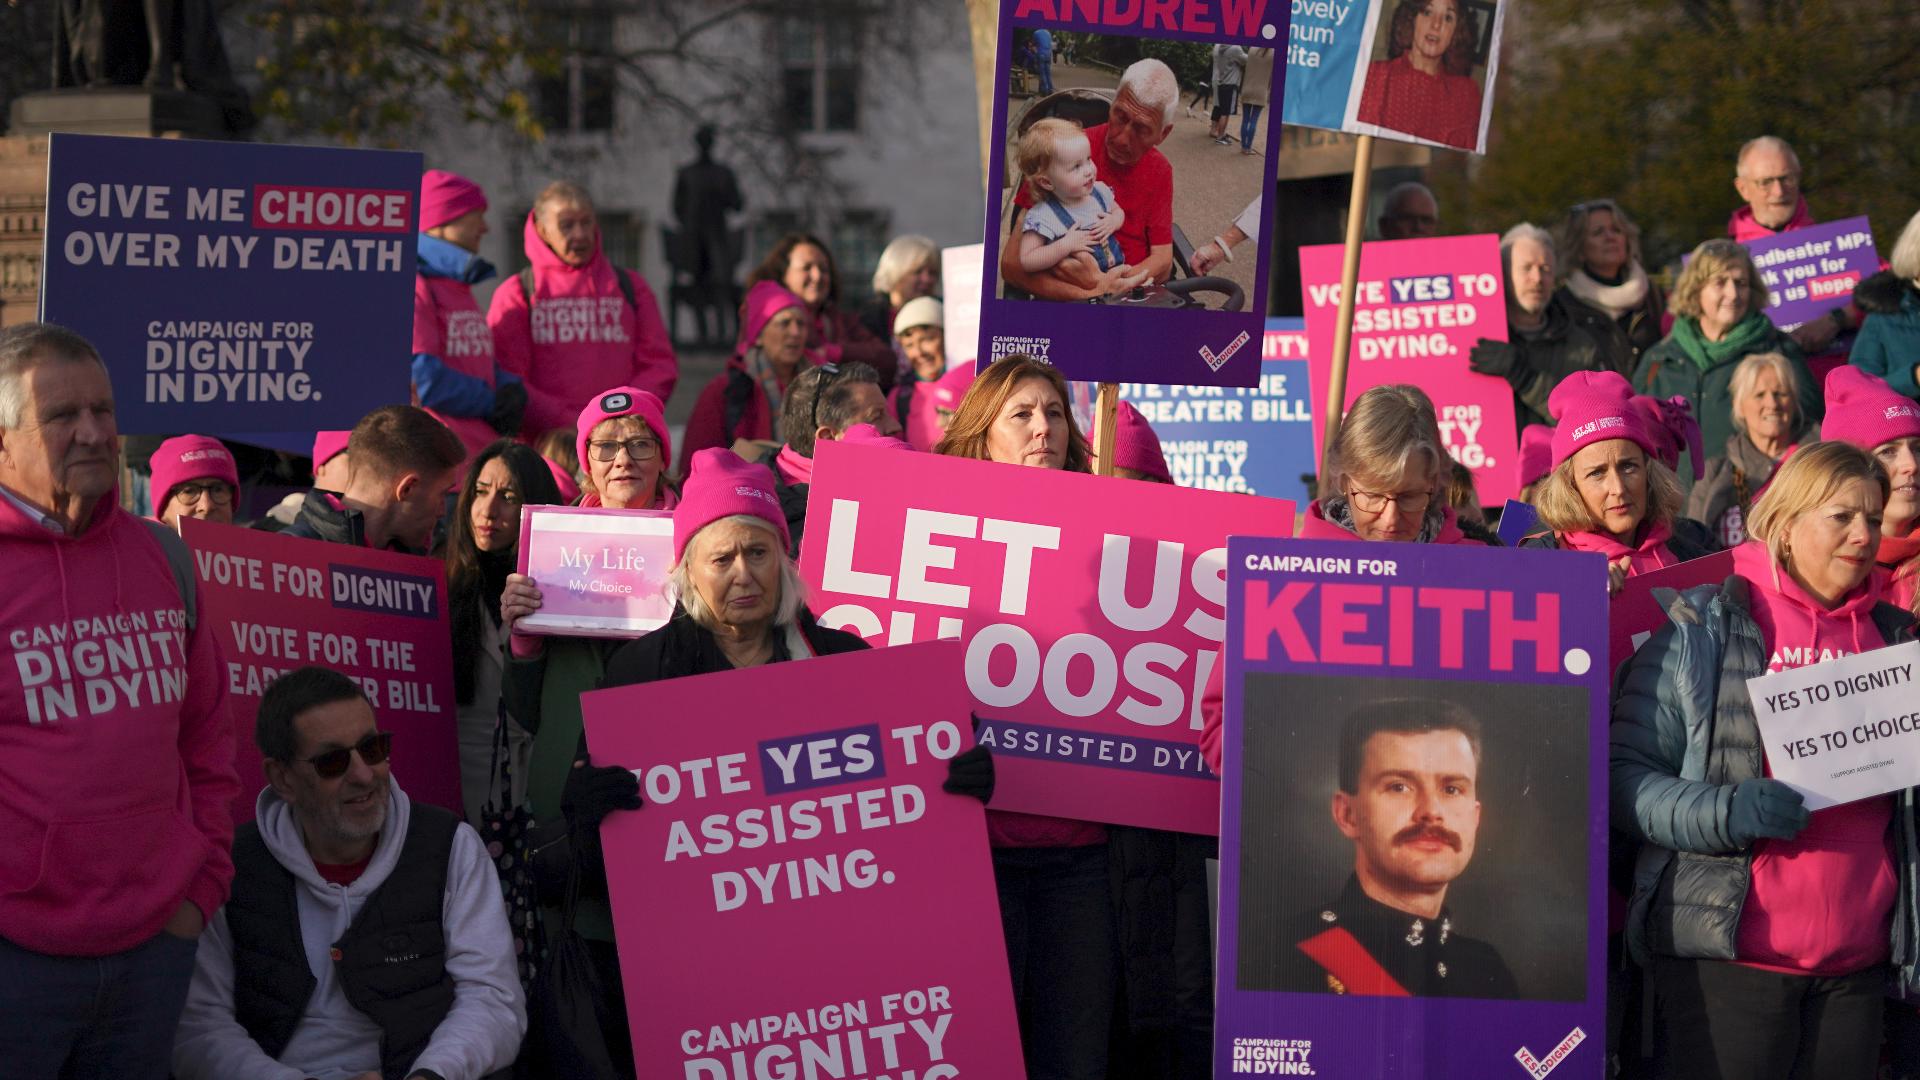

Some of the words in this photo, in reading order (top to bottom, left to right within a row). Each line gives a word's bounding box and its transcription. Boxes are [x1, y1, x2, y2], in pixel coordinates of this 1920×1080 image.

[1291, 0, 1349, 26] ovely
[1287, 45, 1321, 68] ita
[67, 182, 170, 220] GIVE
[186, 187, 245, 222] ME
[260, 190, 406, 227] CHOICE
[64, 231, 181, 267] OVER
[197, 235, 260, 269] MY
[273, 237, 403, 272] DEATH
[1754, 240, 1832, 268] adbeater
[1782, 264, 1817, 285] you
[1820, 258, 1847, 274] for
[1392, 277, 1452, 302] YES
[1459, 274, 1498, 297] TO
[1785, 285, 1808, 301] us
[148, 321, 263, 338] CAMPAIGN
[272, 321, 315, 339] FOR
[532, 307, 622, 326] DIGNITY
[1352, 303, 1477, 334] SSISTED
[991, 342, 1050, 355] DIGNITY
[993, 336, 1033, 344] CAMPAIGN
[1035, 337, 1051, 345] FOR
[1359, 333, 1458, 361] DYING.
[146, 340, 314, 371] DIGNITY
[145, 372, 185, 403] IN
[193, 372, 322, 403] DYING.
[1136, 400, 1243, 423] BEATER
[1251, 400, 1312, 422] BILL
[1442, 405, 1482, 419] FOR
[1214, 440, 1248, 455] FOR
[1174, 474, 1257, 496] YING.
[560, 546, 595, 575] My
[602, 547, 645, 571] Life
[822, 498, 1061, 616] LET
[1098, 533, 1228, 643] US
[1245, 554, 1351, 574] CAMPAIGN
[1357, 559, 1397, 576] FOR
[195, 549, 265, 591] VOTE
[272, 562, 324, 599] FOR
[332, 571, 433, 613] DIGNITY
[569, 579, 588, 594] My
[590, 580, 632, 593] Choice
[10, 612, 149, 649] CAMPAIGN
[154, 609, 187, 629] FOR
[1244, 579, 1591, 675] KEITH.
[14, 631, 187, 687] DIGNITY
[231, 621, 300, 660] VOTE
[307, 631, 359, 666] FOR
[365, 638, 416, 672] THE
[24, 683, 79, 724] IN
[85, 667, 188, 715] DYIN
[387, 679, 441, 713] BILL
[1765, 690, 1801, 713] YES
[1803, 684, 1830, 705] TO
[1835, 664, 1912, 698] DIGNITY
[979, 726, 1137, 763] ASSISTED
[1153, 747, 1215, 774] DYI
[1783, 737, 1818, 761] YES
[1820, 731, 1848, 751] TO
[1852, 712, 1920, 745] CHOICE
[637, 752, 751, 804] OTE
[766, 733, 875, 785] YES
[892, 721, 961, 765] TO
[1834, 768, 1856, 778] SUPPORT
[1857, 763, 1879, 773] ASSISTED
[664, 784, 926, 862] ASSISTED
[712, 848, 896, 912] DYING.
[681, 1000, 868, 1055] CAMPAIGN
[881, 985, 952, 1020] FOR
[684, 1014, 953, 1080] DIGNITY
[1233, 1046, 1311, 1061] DIGNITY
[1234, 1038, 1288, 1048] CAMPAIGN
[1291, 1040, 1312, 1049] FOR
[1233, 1060, 1252, 1073] IN
[1254, 1060, 1316, 1075] DYING.
[1520, 1050, 1538, 1071] YES
